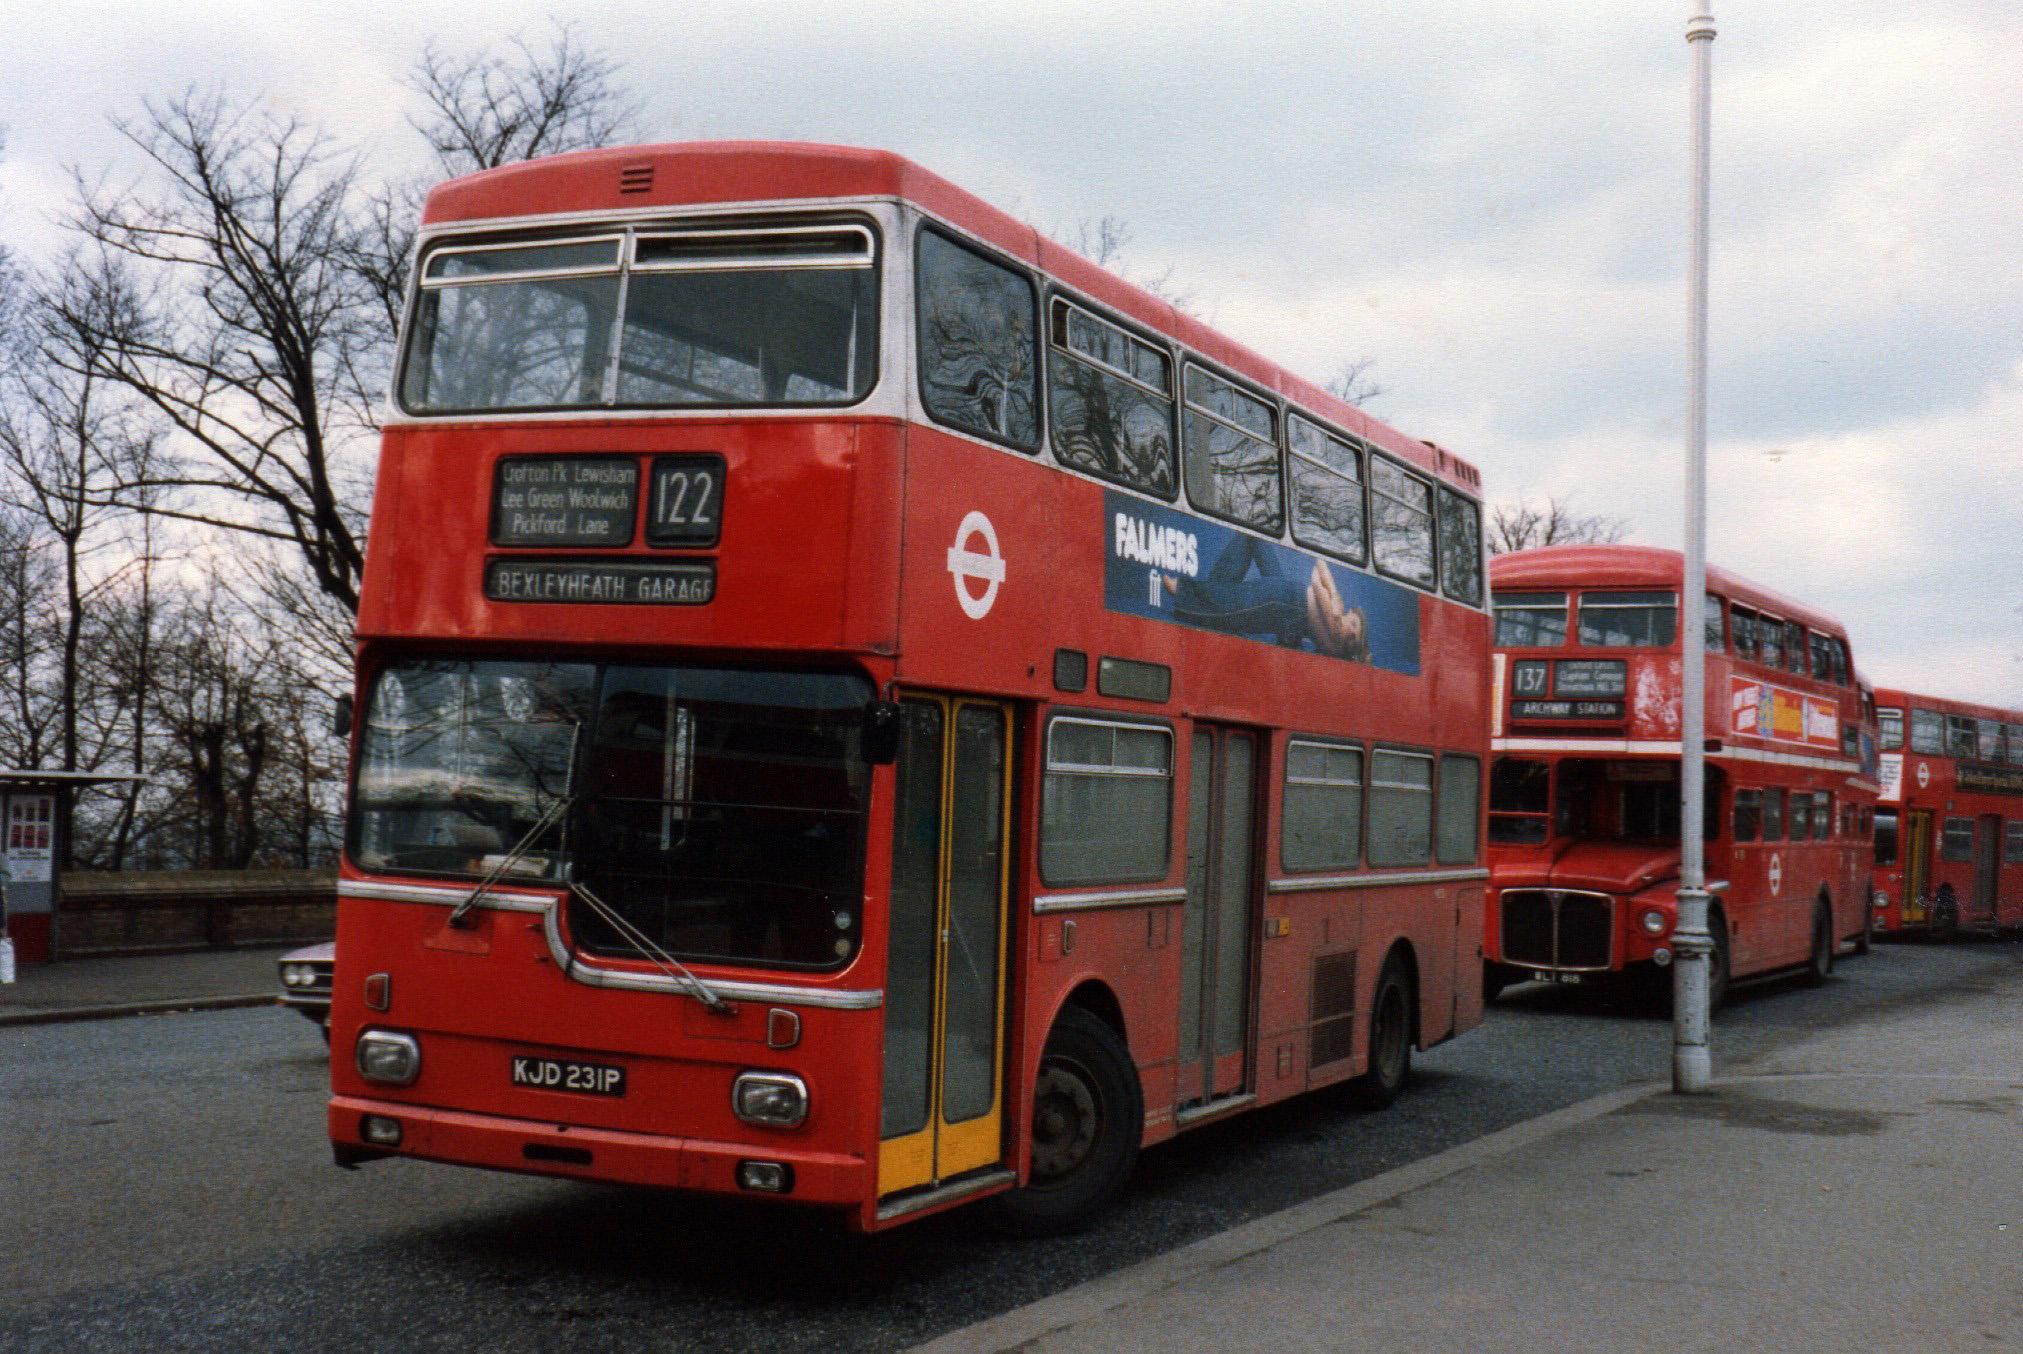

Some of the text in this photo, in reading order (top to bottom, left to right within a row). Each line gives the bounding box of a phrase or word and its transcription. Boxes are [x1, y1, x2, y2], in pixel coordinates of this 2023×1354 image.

[575, 463, 636, 483] Lewisham
[502, 487, 629, 509] Lee Green Woolwich
[657, 472, 713, 523] 122
[512, 513, 610, 534] Pickford Lane
[1115, 512, 1199, 577] FALMERS
[499, 571, 626, 598] BEXLEYHEATH
[1516, 668, 1546, 691] 137
[513, 1058, 621, 1092] KJD 231P
